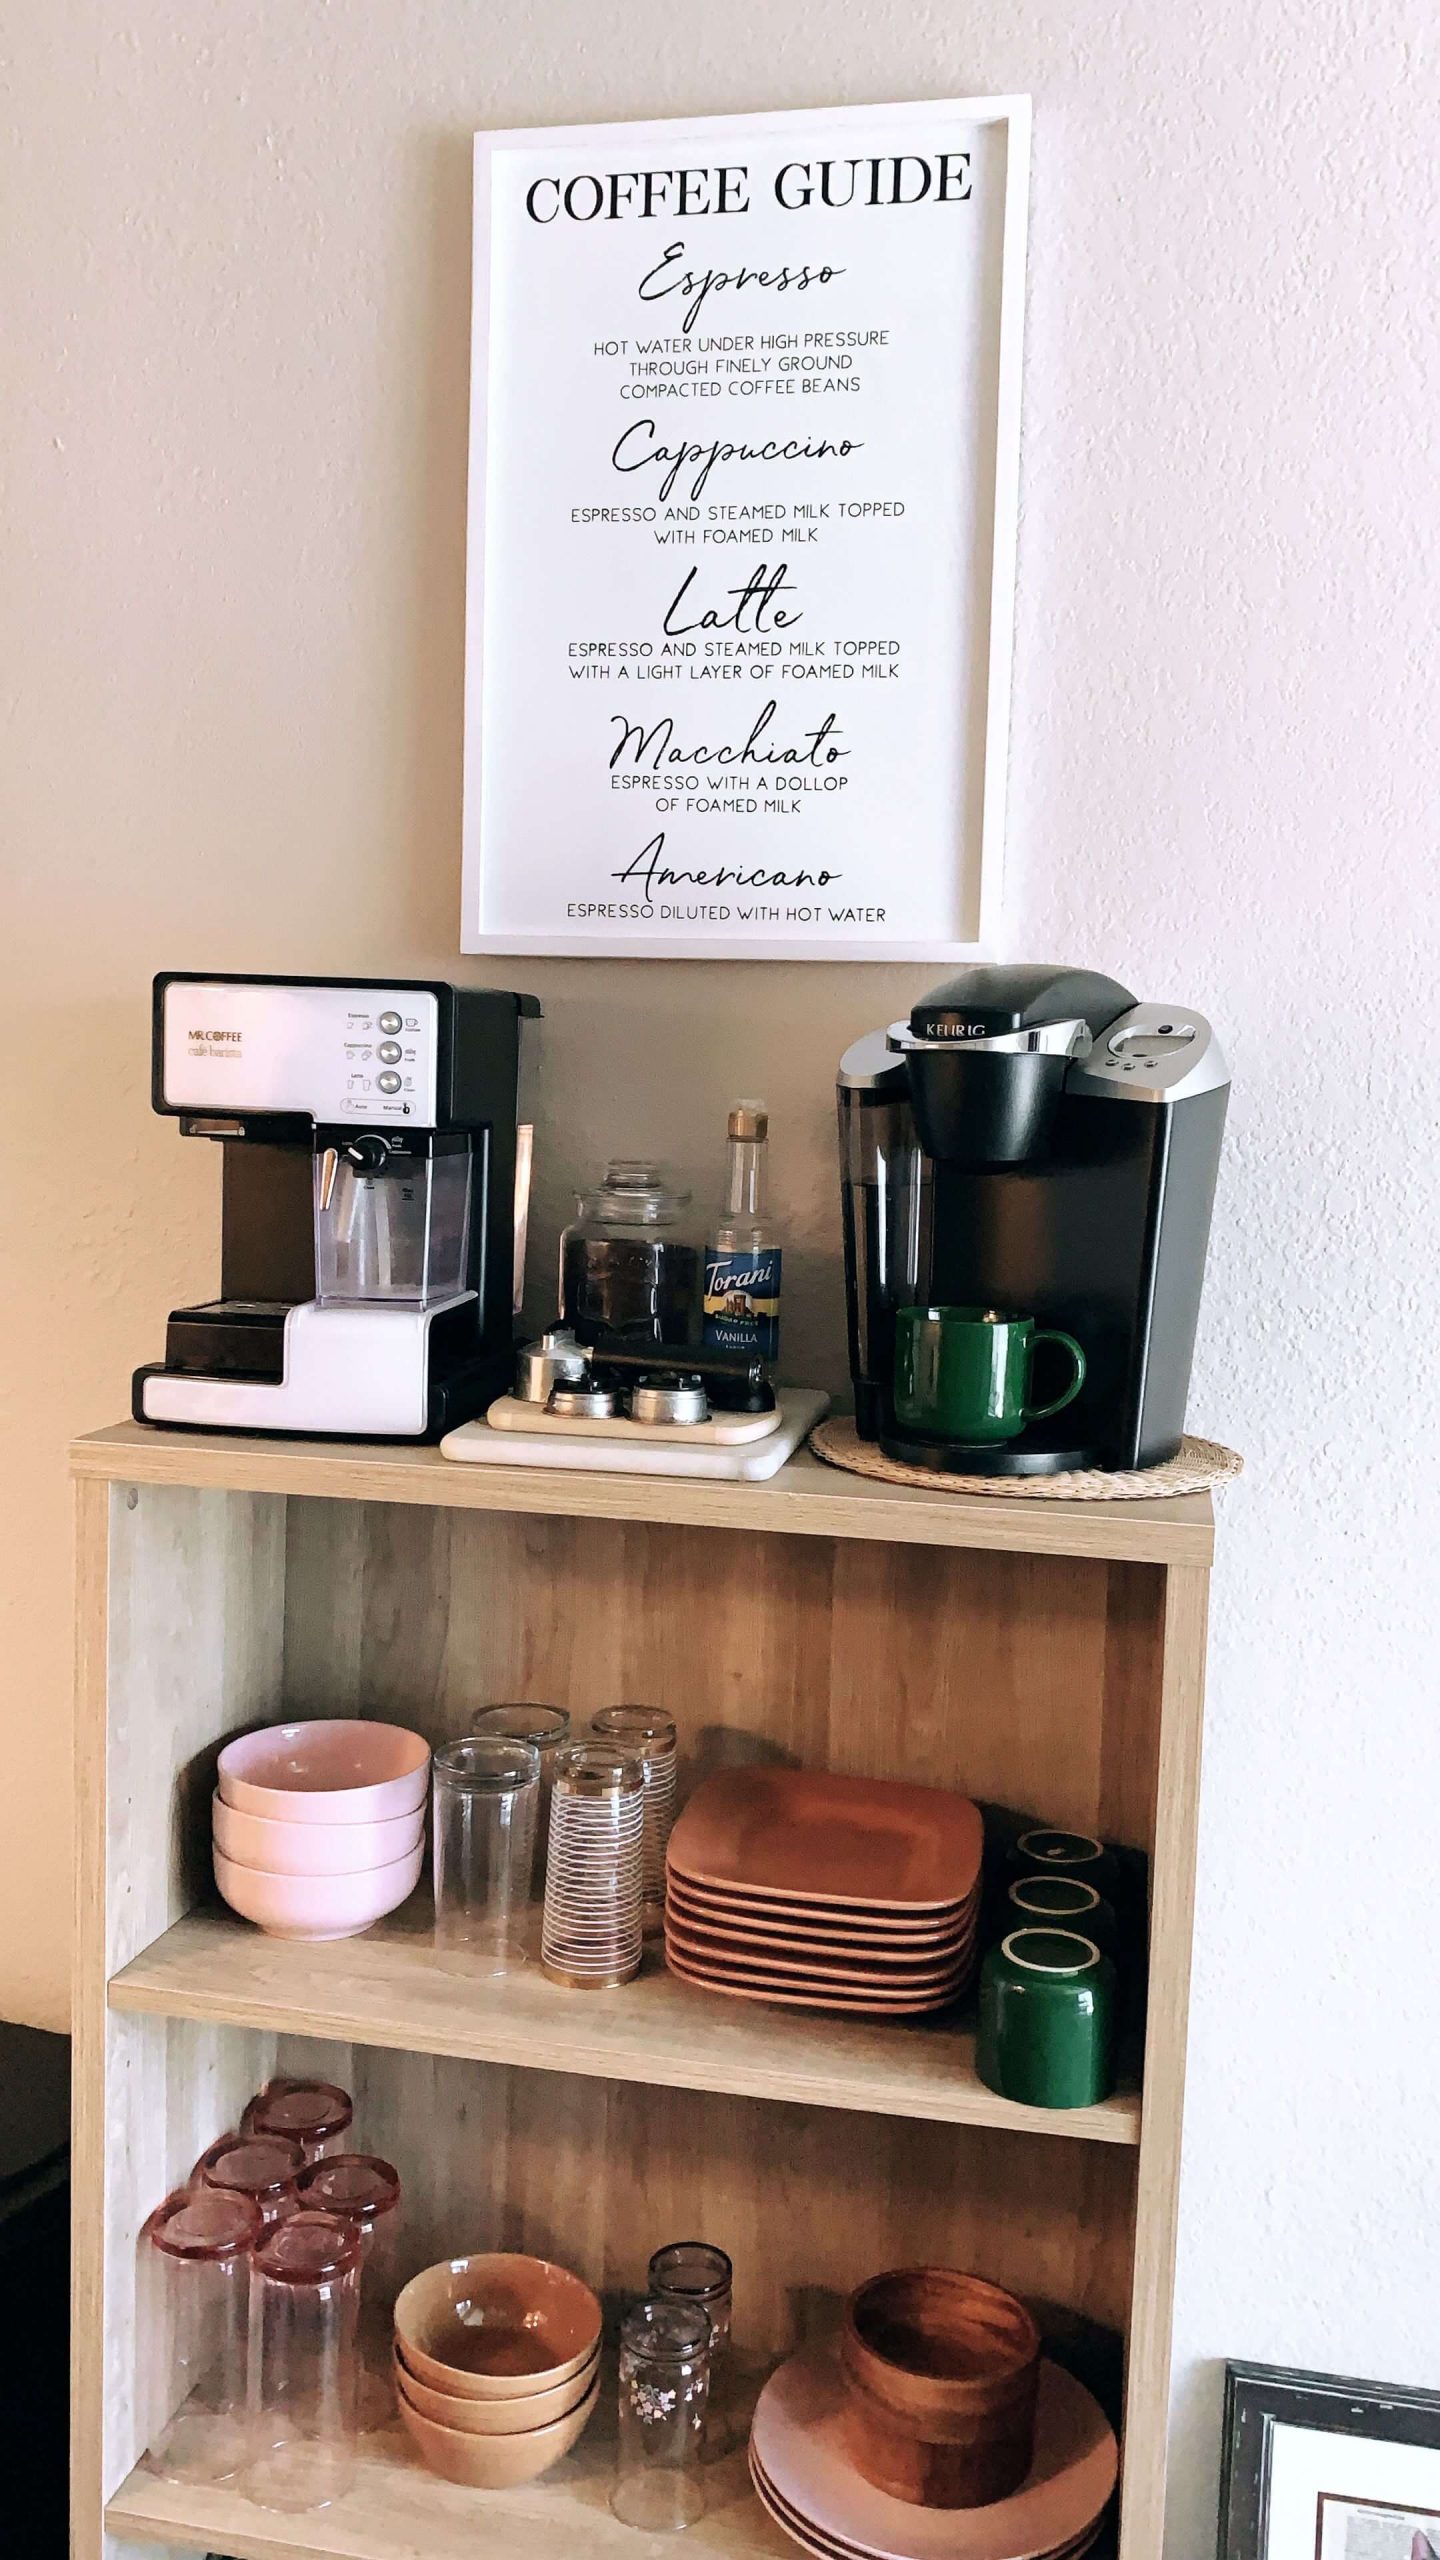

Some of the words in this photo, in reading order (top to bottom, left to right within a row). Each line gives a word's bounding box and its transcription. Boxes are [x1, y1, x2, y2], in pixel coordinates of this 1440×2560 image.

[526, 166, 750, 223] COFFEE
[775, 153, 972, 210] GUIDE
[639, 241, 847, 334] Espresso
[594, 341, 628, 355] HOT
[636, 338, 691, 354] WATER
[699, 336, 754, 352] UNDER
[761, 334, 797, 349] HIGH
[805, 330, 889, 347] PRESSURE
[630, 360, 708, 376] THROUGH
[716, 358, 771, 373] FINELY
[779, 355, 852, 371] GROUND
[620, 382, 721, 399] COMPACTED
[728, 379, 795, 395] COFFEE
[802, 377, 860, 393] BEANS
[612, 419, 864, 502] Cappuccino
[572, 507, 656, 522] ESPRESSO
[664, 507, 700, 520] AND
[708, 505, 786, 520] STEAMED
[794, 504, 829, 518] MILK
[838, 502, 904, 517] TOPPED
[654, 530, 694, 544] WITH
[704, 529, 773, 543] FOAMED
[782, 528, 818, 542] MILK
[663, 563, 803, 636] Latte
[569, 643, 653, 657] ESPRESSO
[661, 643, 696, 656] AND
[705, 642, 782, 656] STEAMED
[790, 642, 825, 656] MILK
[834, 641, 900, 655] TOPPED
[569, 665, 609, 679] WITH
[617, 665, 630, 679] A
[638, 665, 682, 679] LIGHT
[691, 665, 742, 679] LAYER
[750, 665, 774, 679] OF
[782, 664, 854, 679] FOAMED
[862, 664, 899, 678] MILK
[609, 700, 851, 770] Macchiato
[612, 775, 699, 790] ESPRESSO
[707, 776, 749, 790] WITH
[755, 776, 769, 791] A
[776, 777, 848, 791] DOLLOP
[656, 798, 679, 812] OF
[687, 798, 757, 812] FOAMED
[764, 800, 801, 813] MILK
[611, 832, 842, 902] Americano
[568, 904, 653, 918] ESPRESSO
[661, 905, 730, 920] DILUTED
[737, 907, 779, 920] WITH
[786, 908, 821, 921] HOT
[828, 908, 885, 922] WATER
[926, 1023, 986, 1037] KEURIG
[706, 1260, 773, 1301] Torani
[715, 1329, 758, 1343] VANILLA
